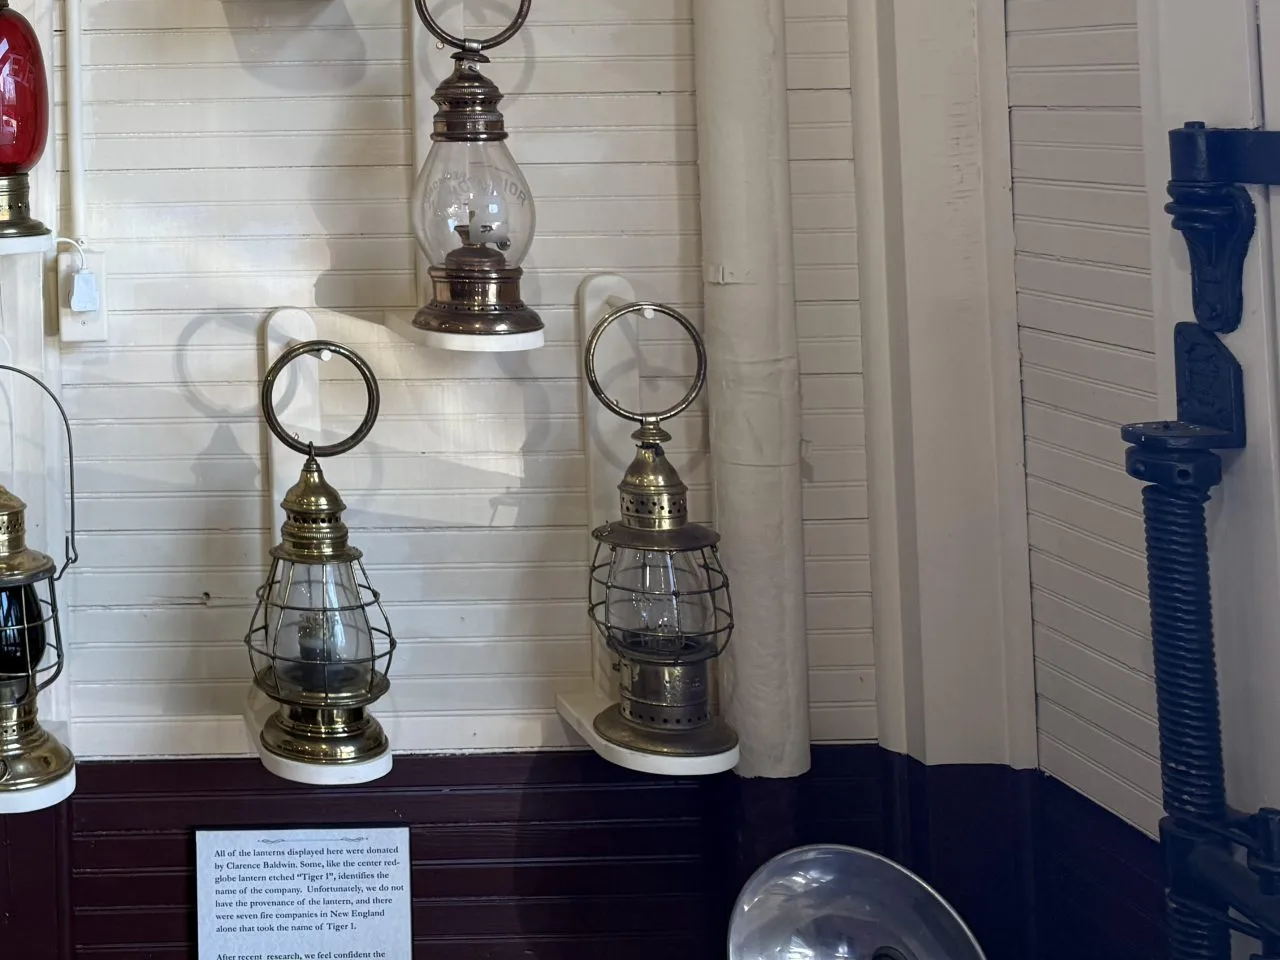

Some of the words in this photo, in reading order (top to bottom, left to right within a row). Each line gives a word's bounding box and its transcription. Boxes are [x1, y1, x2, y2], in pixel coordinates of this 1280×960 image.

[253, 849, 285, 857] lanterns
[287, 847, 324, 857] displayed
[366, 846, 399, 854] donated
[214, 862, 224, 872] by
[226, 862, 260, 870] Clarence
[300, 860, 324, 869] Some,
[214, 875, 236, 884] globe
[338, 872, 375, 880] identifies
[264, 887, 302, 896] company.
[307, 885, 364, 894] Unfortunately,
[250, 899, 295, 909] provenance
[308, 897, 321, 905] the
[322, 896, 354, 906] lantern,
[355, 896, 370, 904] and
[372, 895, 393, 904] there
[275, 910, 318, 921] companies
[351, 909, 385, 919] England
[326, 922, 348, 932] Tiger
[333, 950, 371, 959] confident
